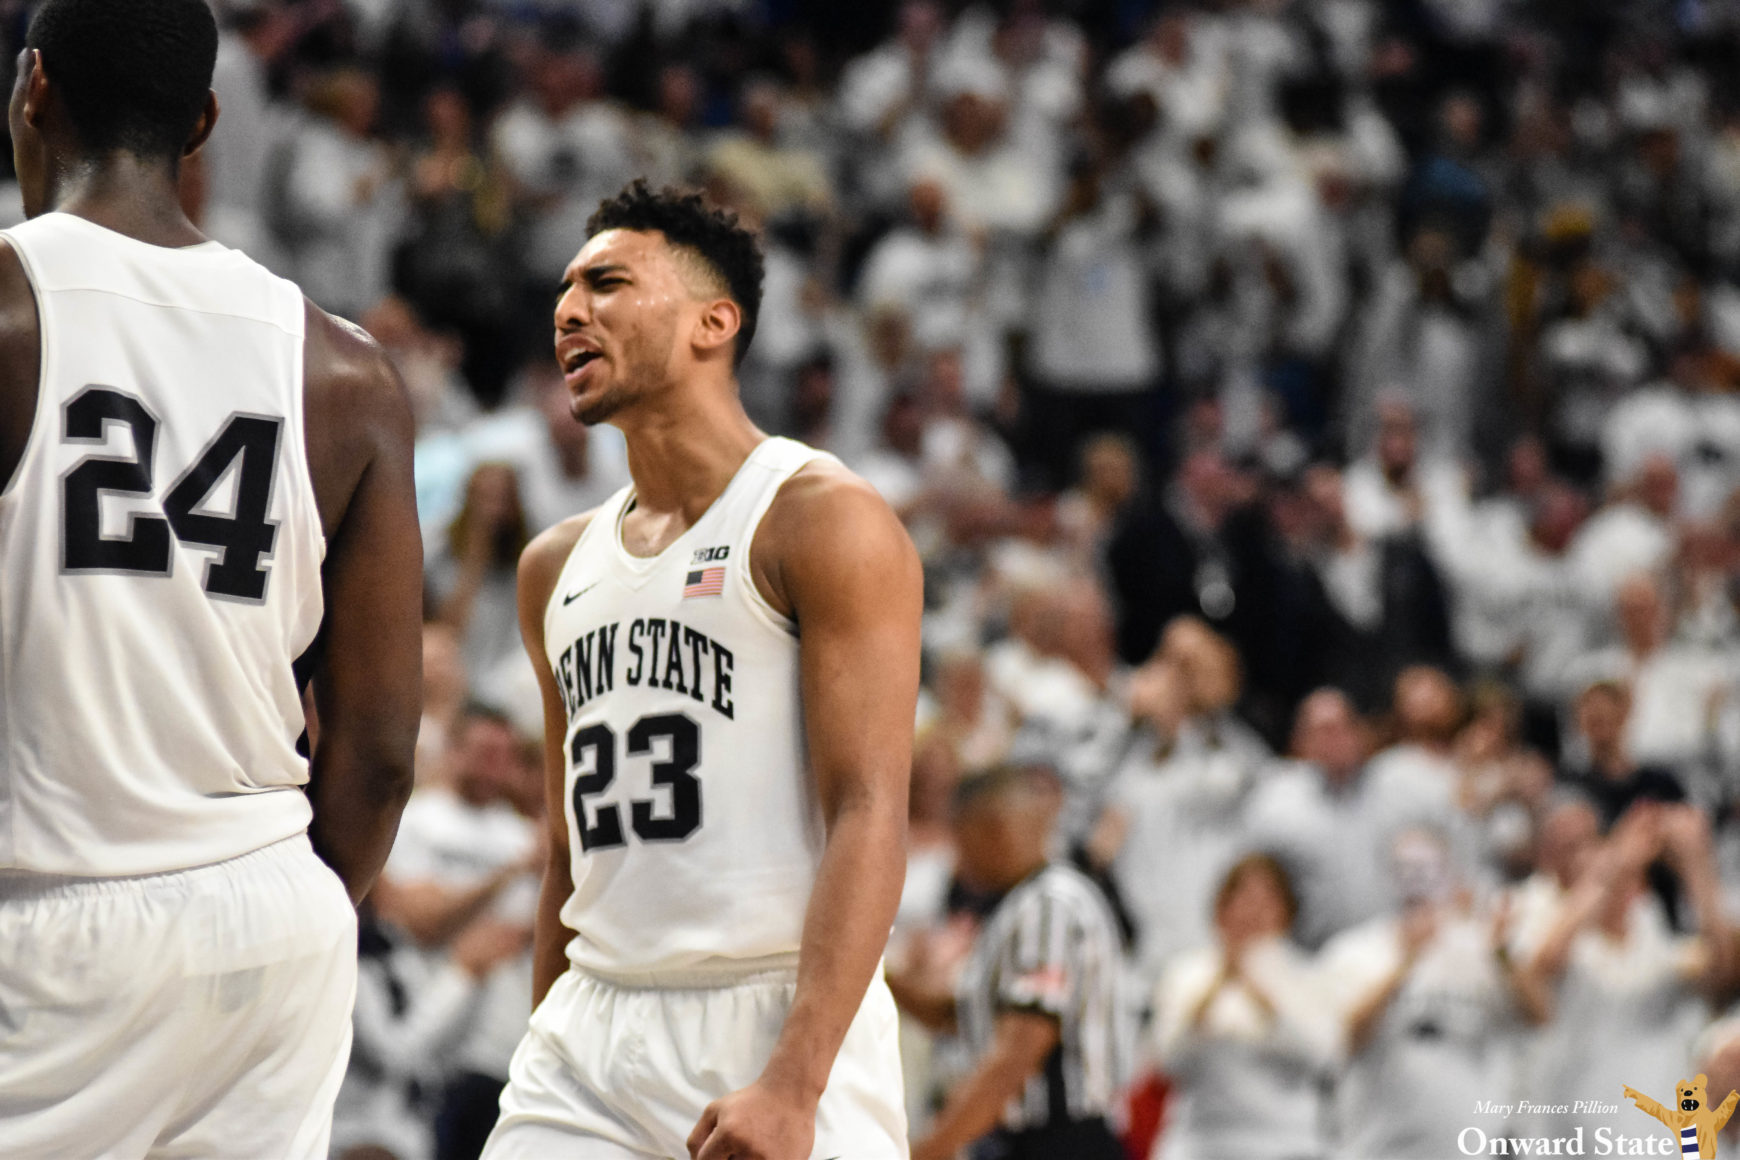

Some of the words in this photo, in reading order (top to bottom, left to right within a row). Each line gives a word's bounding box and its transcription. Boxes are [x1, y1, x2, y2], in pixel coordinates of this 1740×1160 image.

[58, 384, 285, 606] 24
[626, 618, 734, 720] STATE
[571, 711, 704, 856] 23
